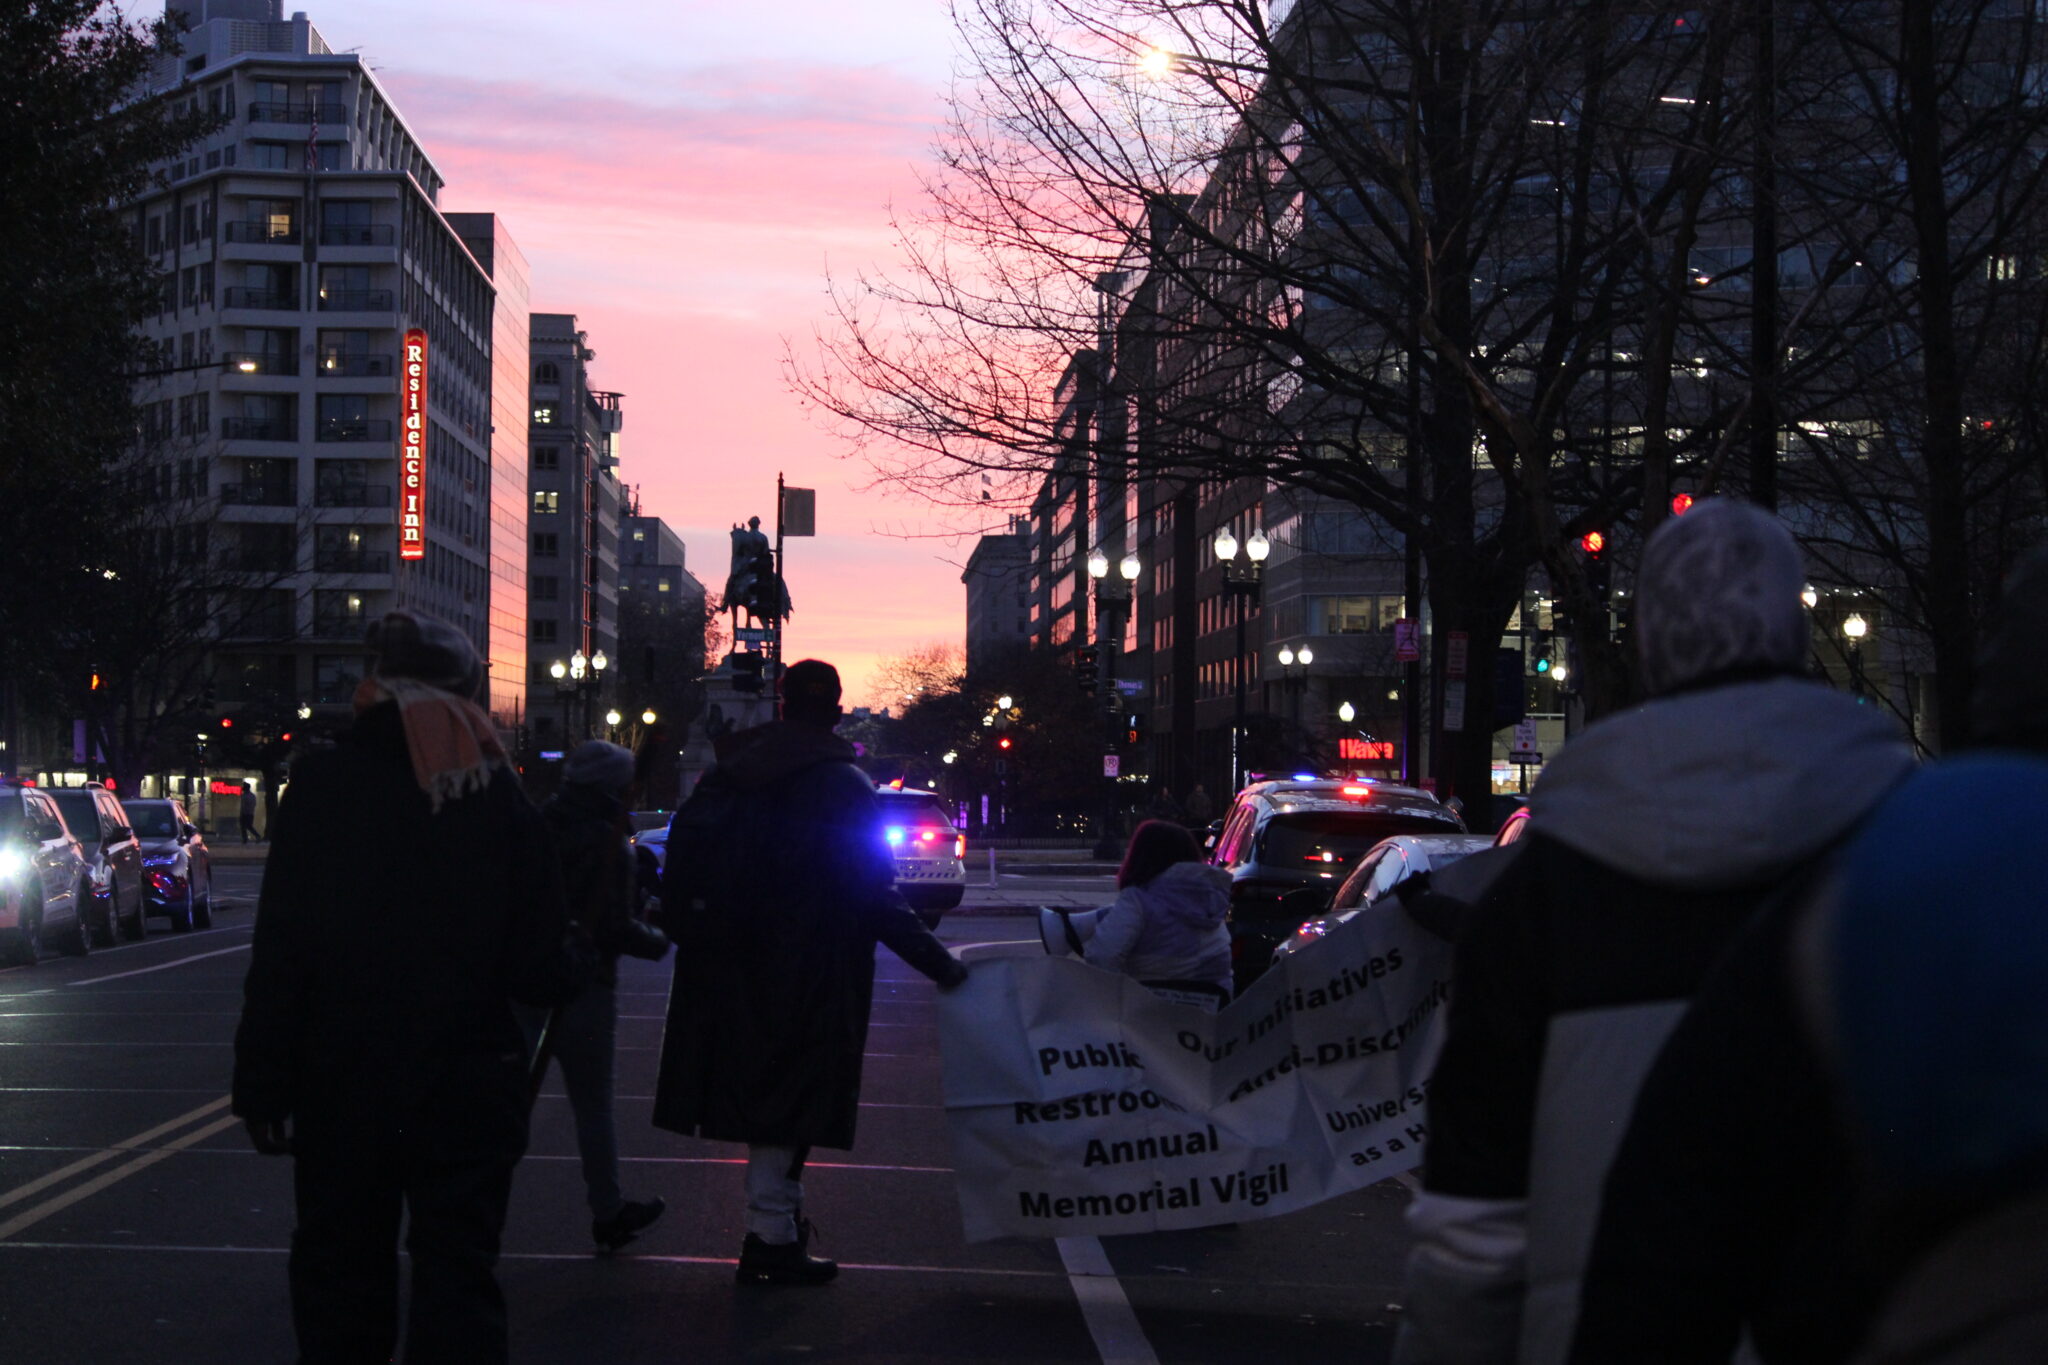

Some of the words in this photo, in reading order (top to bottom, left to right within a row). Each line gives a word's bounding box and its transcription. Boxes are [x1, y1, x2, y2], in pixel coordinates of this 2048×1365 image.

[405, 345, 422, 488] Residence
[404, 495, 420, 541] Inn
[1339, 739, 1394, 759] Wawa
[1178, 1030, 1239, 1063] Our
[1248, 947, 1403, 1044] Initiatives
[1084, 1123, 1220, 1168] Annual
[1350, 1146, 1383, 1166] as
[1386, 1138, 1406, 1153] a
[1018, 1177, 1201, 1219] Memorial
[1210, 1163, 1289, 1207] Vigil
